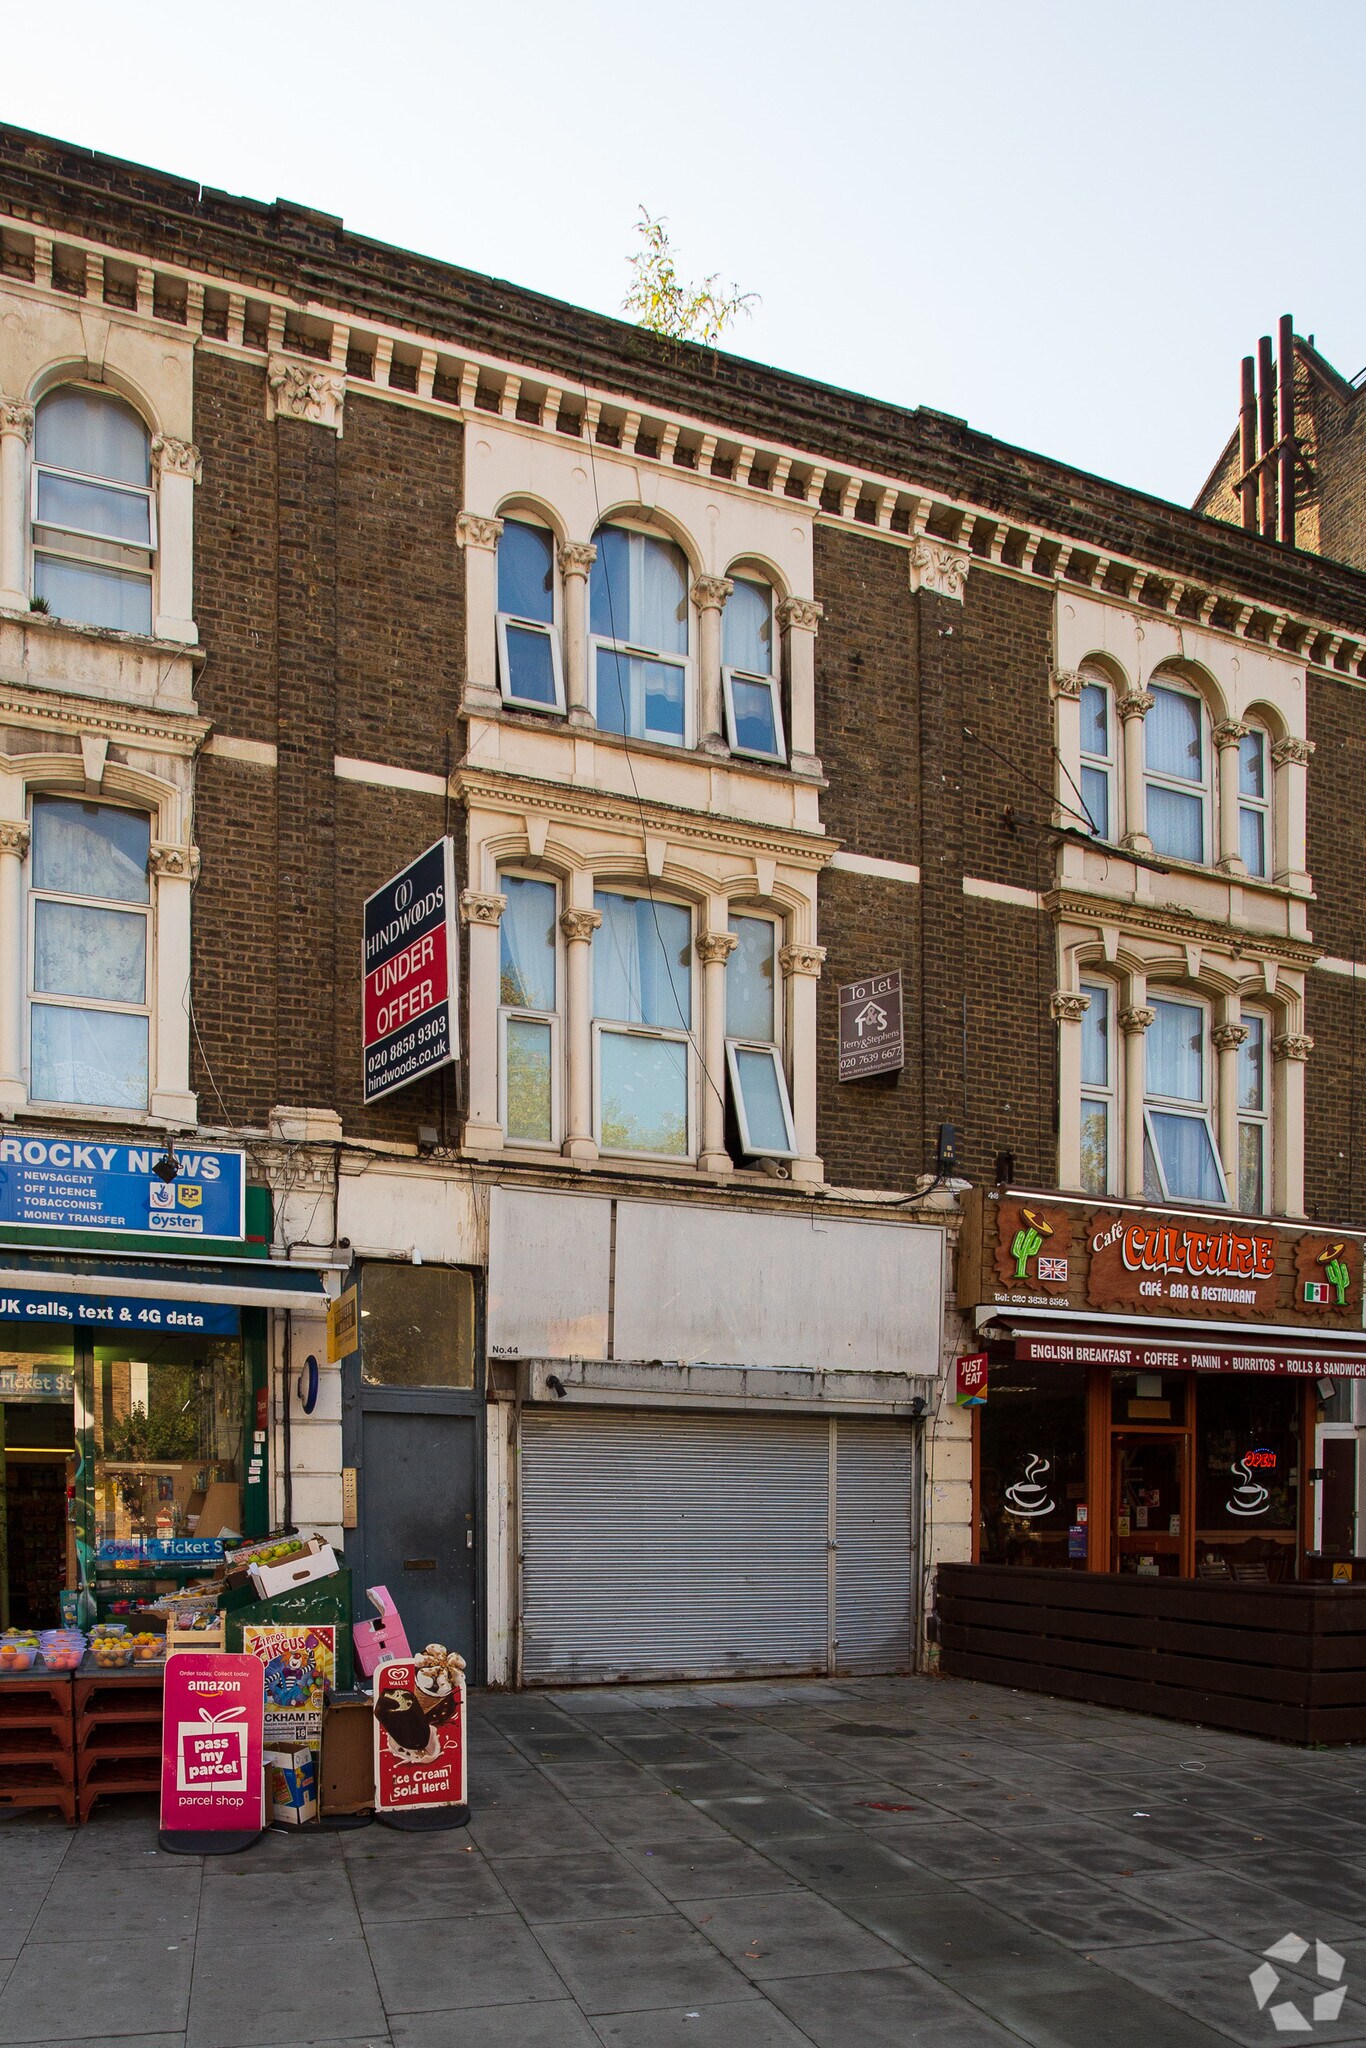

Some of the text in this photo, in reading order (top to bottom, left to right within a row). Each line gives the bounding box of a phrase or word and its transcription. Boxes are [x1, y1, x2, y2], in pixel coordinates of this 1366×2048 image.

[367, 885, 444, 959] HINDWOODS
[375, 935, 434, 996] UNDER
[849, 978, 891, 1000] To Let
[376, 979, 434, 1034] OFFER
[368, 1016, 446, 1072] 020 8858 9303
[368, 1039, 446, 1092] hindwoods.co.uk
[840, 1046, 900, 1069] 020 7639 6677
[0, 1140, 118, 1170] ROCKY
[24, 1171, 94, 1184] NEWSAGENT
[24, 1184, 97, 1198] OFF LICENCE
[24, 1197, 104, 1210] TOBACCONIST
[24, 1210, 126, 1225] MONEY TRANSFER
[151, 1214, 198, 1228] oyster
[1093, 1220, 1275, 1279] Café CULTURE
[1139, 1280, 1257, 1304] CAFÉ BAR & RESTAURANT
[26, 1302, 73, 1320] calls,
[79, 1304, 114, 1321] text
[119, 1307, 133, 1322] &
[138, 1309, 161, 1323] 4G
[166, 1311, 204, 1327] data
[492, 1345, 518, 1354] No.44
[961, 1359, 983, 1376] JUST
[1030, 1344, 1366, 1376] ENGLISH BREAKFAST COFFEE PANINI BURRITOS ROLLS & SANDWICH
[55, 1375, 73, 1391] St
[965, 1371, 983, 1386] EAT
[1245, 1450, 1276, 1468] OPEN
[160, 1539, 210, 1554] Ticket
[250, 1632, 285, 1651] ZIPPOS
[255, 1636, 306, 1669] CIRCUS
[188, 1680, 241, 1691] amazon
[264, 1712, 305, 1722] CKHAM
[296, 1729, 306, 1737] 18
[194, 1738, 229, 1753] pass
[200, 1751, 224, 1764] my
[189, 1760, 239, 1779] parcel
[413, 1769, 449, 1782] Cream
[393, 1778, 450, 1798] Sold Here!
[178, 1795, 244, 1806] parcel shop
